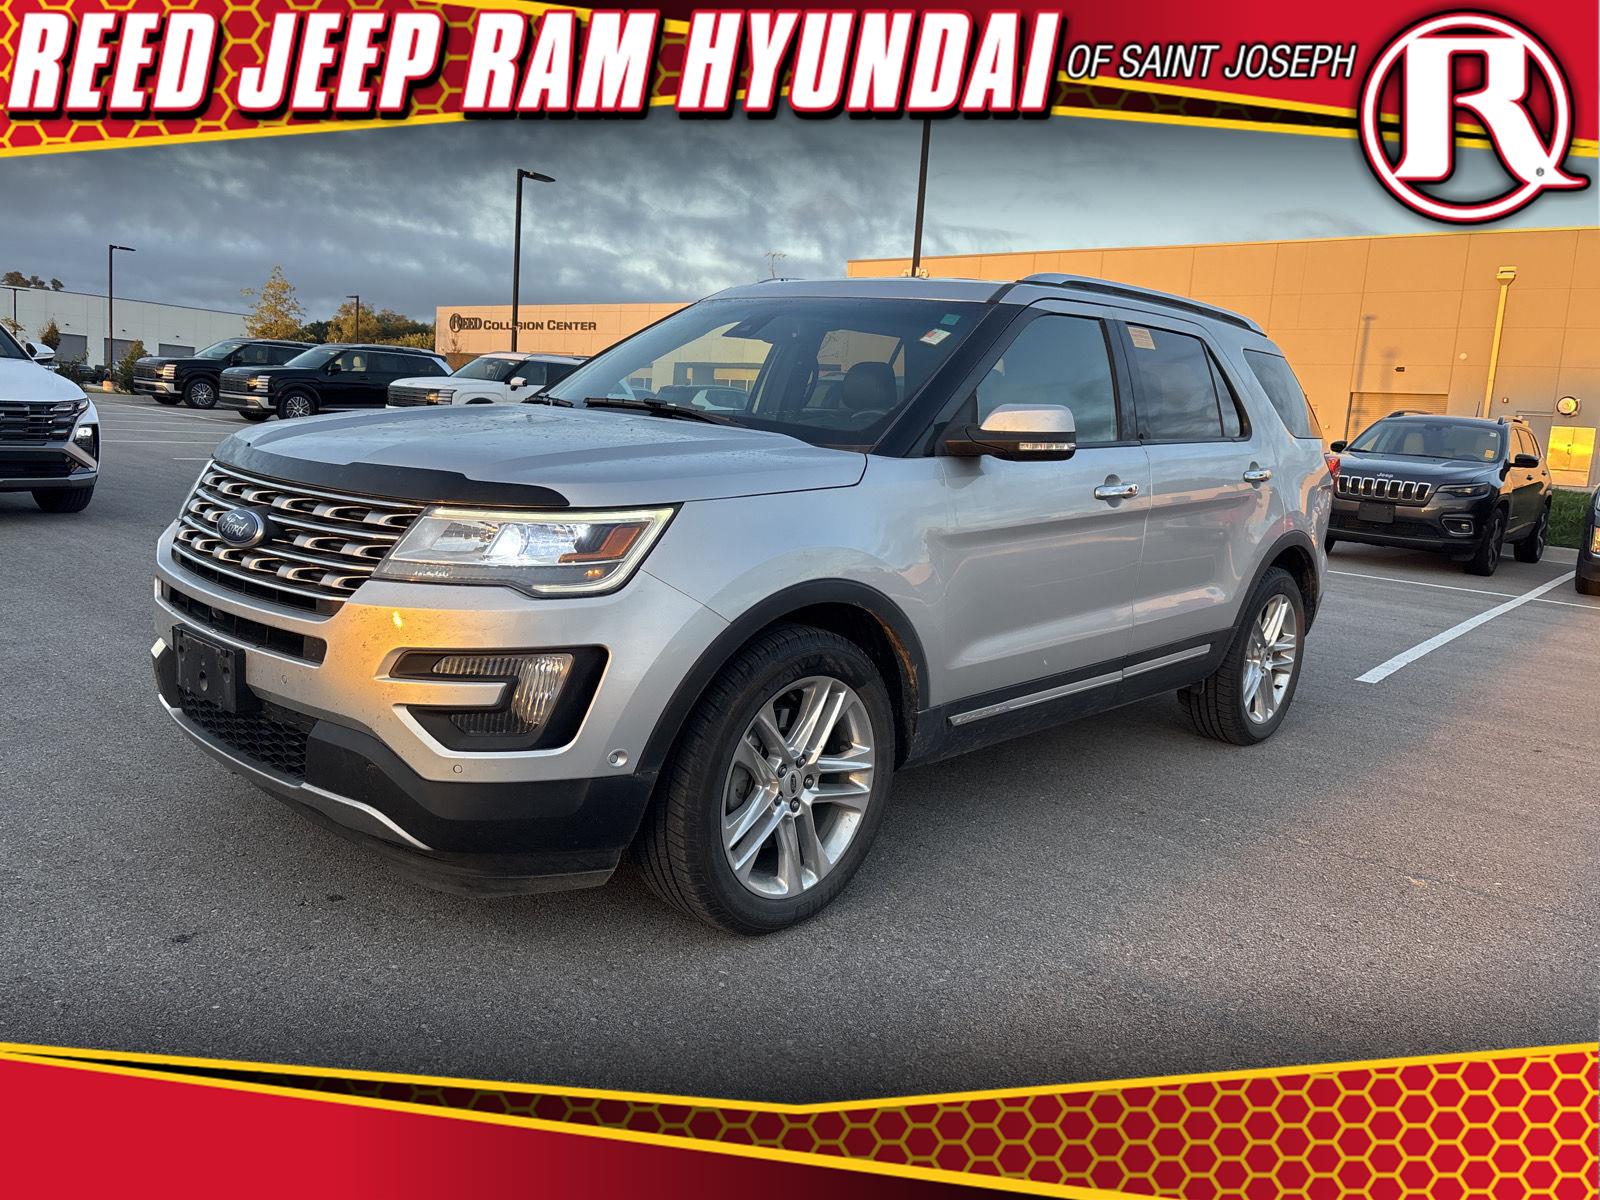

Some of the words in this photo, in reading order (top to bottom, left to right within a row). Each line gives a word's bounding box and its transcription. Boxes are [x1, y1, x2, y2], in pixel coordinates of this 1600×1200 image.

[449, 313, 482, 333] REED
[483, 319, 544, 331] COLLSION
[547, 319, 597, 331] CENTER
[221, 512, 249, 537] Ford
